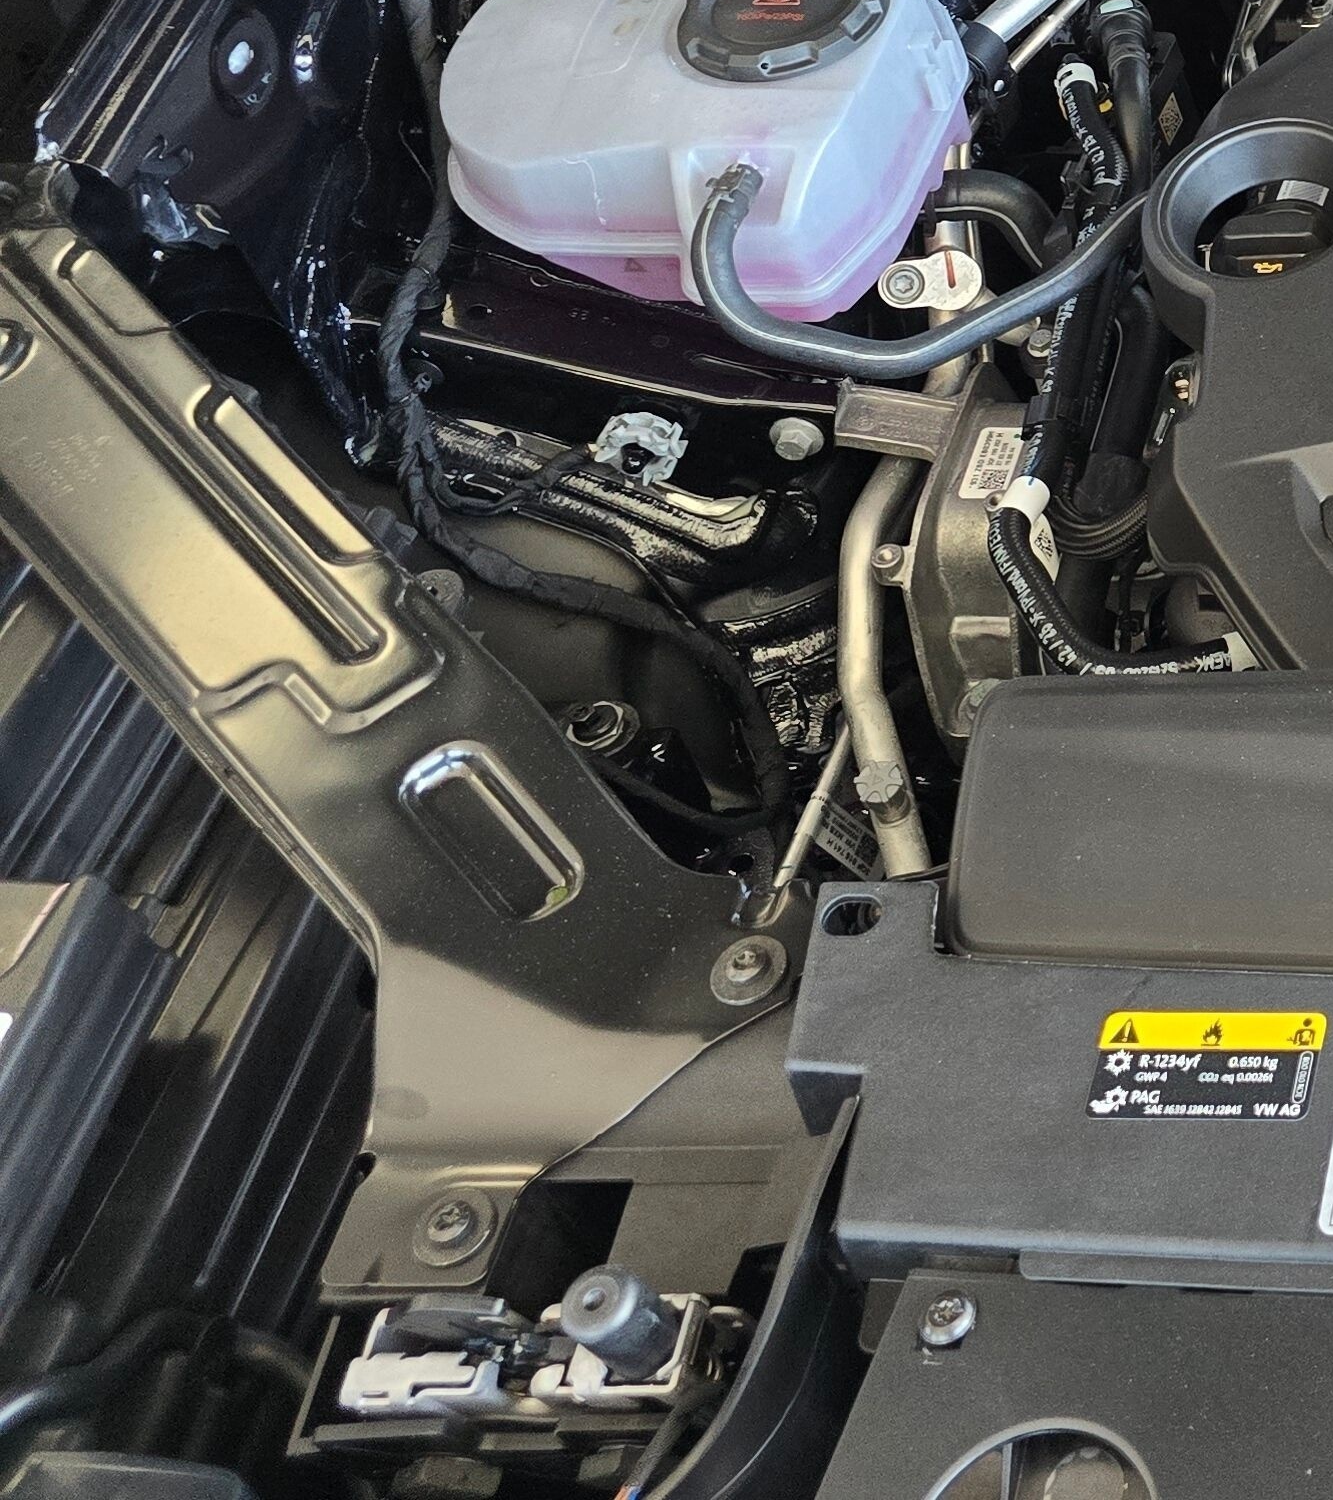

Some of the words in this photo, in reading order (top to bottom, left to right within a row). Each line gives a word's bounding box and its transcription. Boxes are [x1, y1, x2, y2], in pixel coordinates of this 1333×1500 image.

[1138, 1053, 1202, 1071] R-1234yf
[1227, 1056, 1261, 1069] 0.650
[1263, 1057, 1279, 1071] kg
[1130, 1090, 1160, 1104] PAG
[1253, 1103, 1278, 1116] VW
[1278, 1104, 1301, 1116] AG
